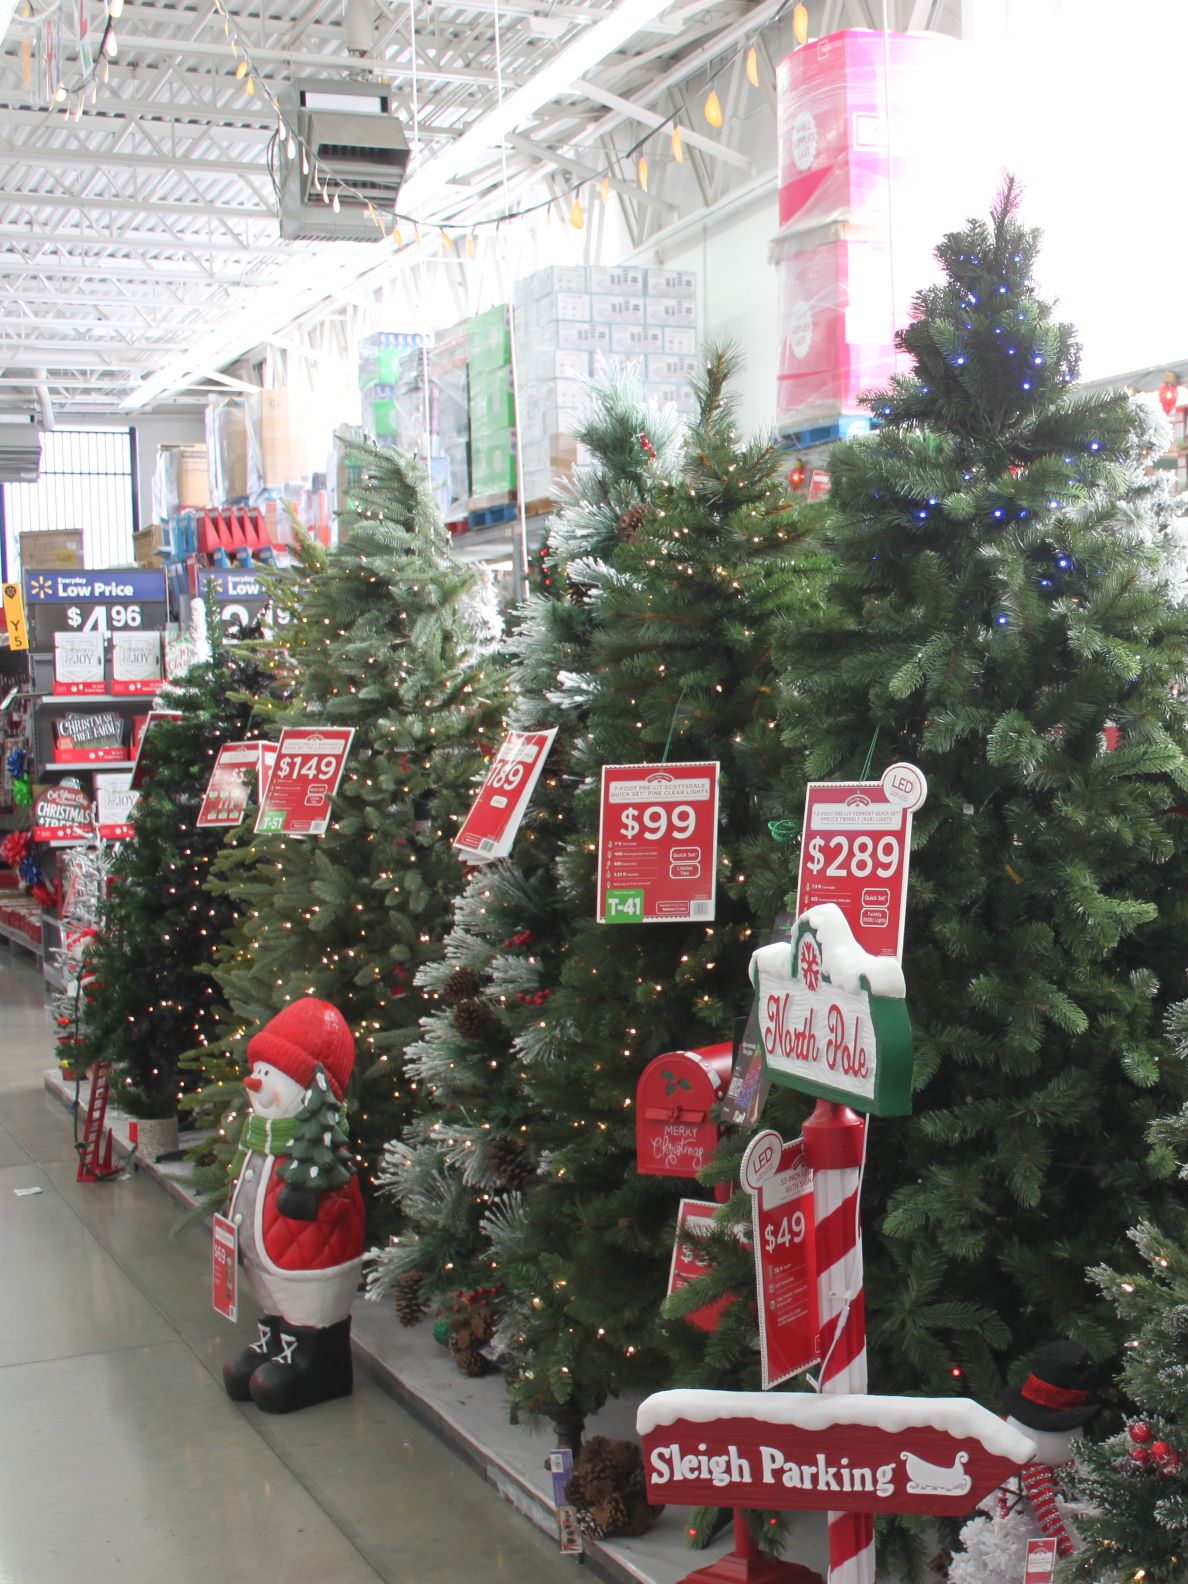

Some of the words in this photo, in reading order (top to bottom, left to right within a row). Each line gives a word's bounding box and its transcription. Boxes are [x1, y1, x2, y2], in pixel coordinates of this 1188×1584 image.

[57, 577, 86, 585] Everyday
[57, 584, 91, 597] Low
[94, 581, 134, 597] Price
[228, 583, 260, 595] Low
[11, 620, 20, 632] Y
[14, 636, 23, 647] 5
[59, 714, 112, 736] CHRISTMAS
[73, 730, 93, 742] TREE
[93, 722, 116, 738] FARM
[277, 756, 337, 780] $149
[891, 774, 913, 794] LED
[37, 801, 91, 824] CHRISTMAS
[262, 817, 283, 829] T-51
[619, 805, 696, 840] $99
[807, 835, 900, 878] $289
[607, 898, 641, 915] T-41
[764, 992, 819, 1062] North
[826, 1003, 869, 1079] Pole
[664, 1125, 698, 1138] MERRY
[650, 1136, 704, 1169] Christmas
[752, 1147, 773, 1174] LED
[764, 1211, 805, 1254] $49
[650, 1442, 752, 1488] Sleigh
[759, 1446, 897, 1498] Parking
